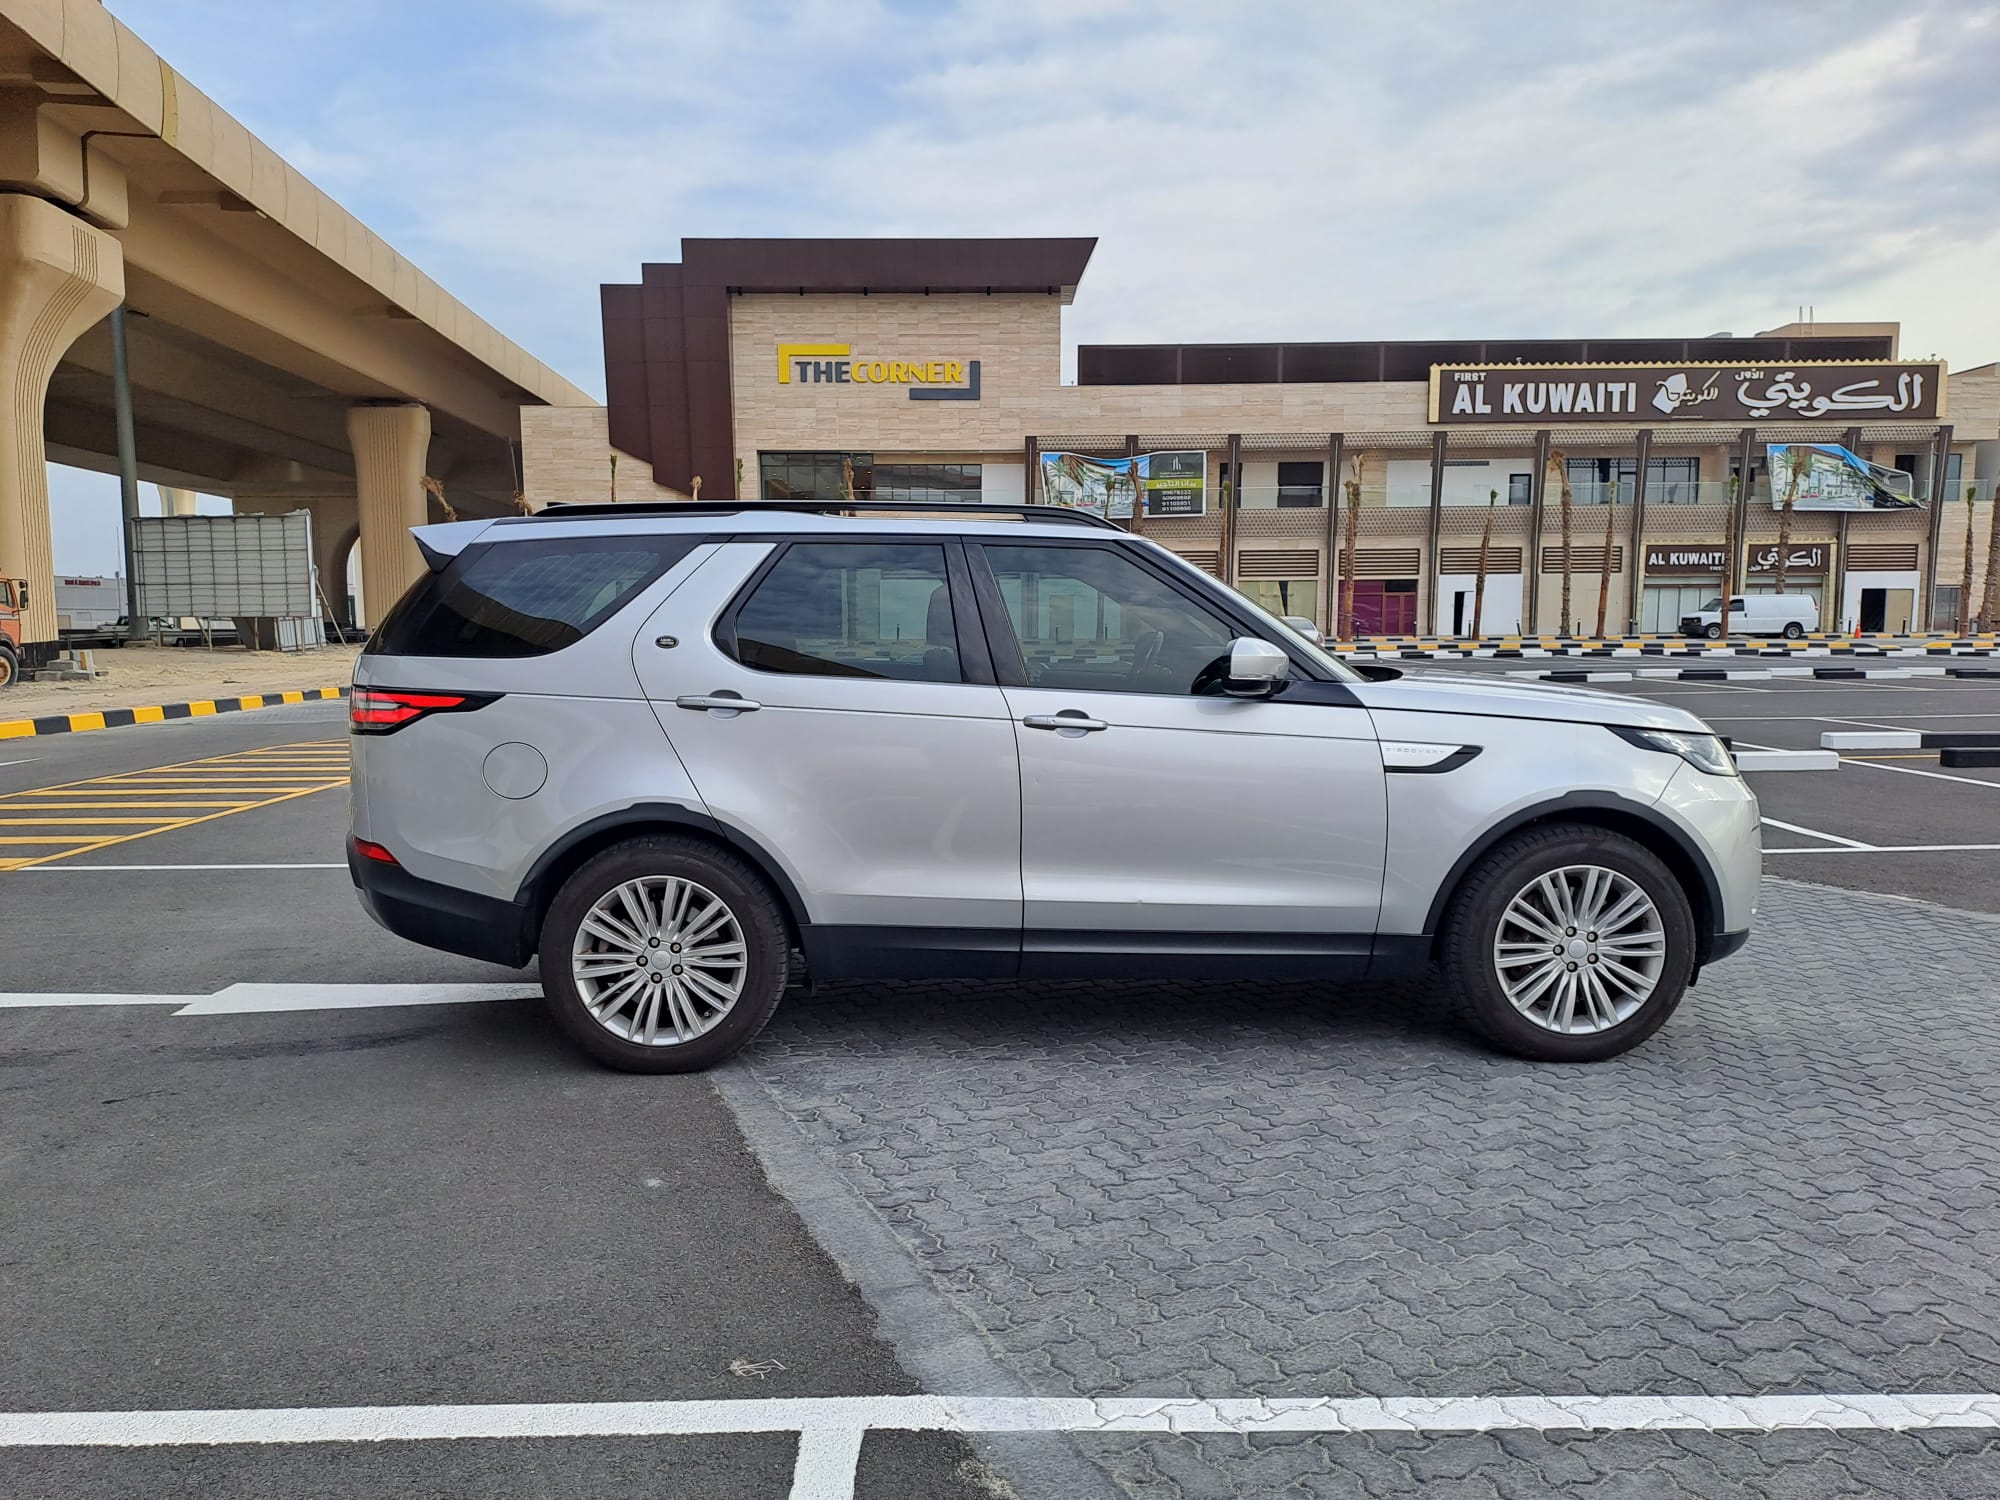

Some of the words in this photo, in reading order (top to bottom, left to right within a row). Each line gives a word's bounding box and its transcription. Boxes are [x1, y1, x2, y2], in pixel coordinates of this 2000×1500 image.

[1454, 372, 1486, 382] FIRST
[1452, 383, 1491, 414] AL
[1503, 382, 1637, 414] KUWAITI
[1737, 371, 1924, 418] الكويتي
[1648, 552, 1666, 565] AL
